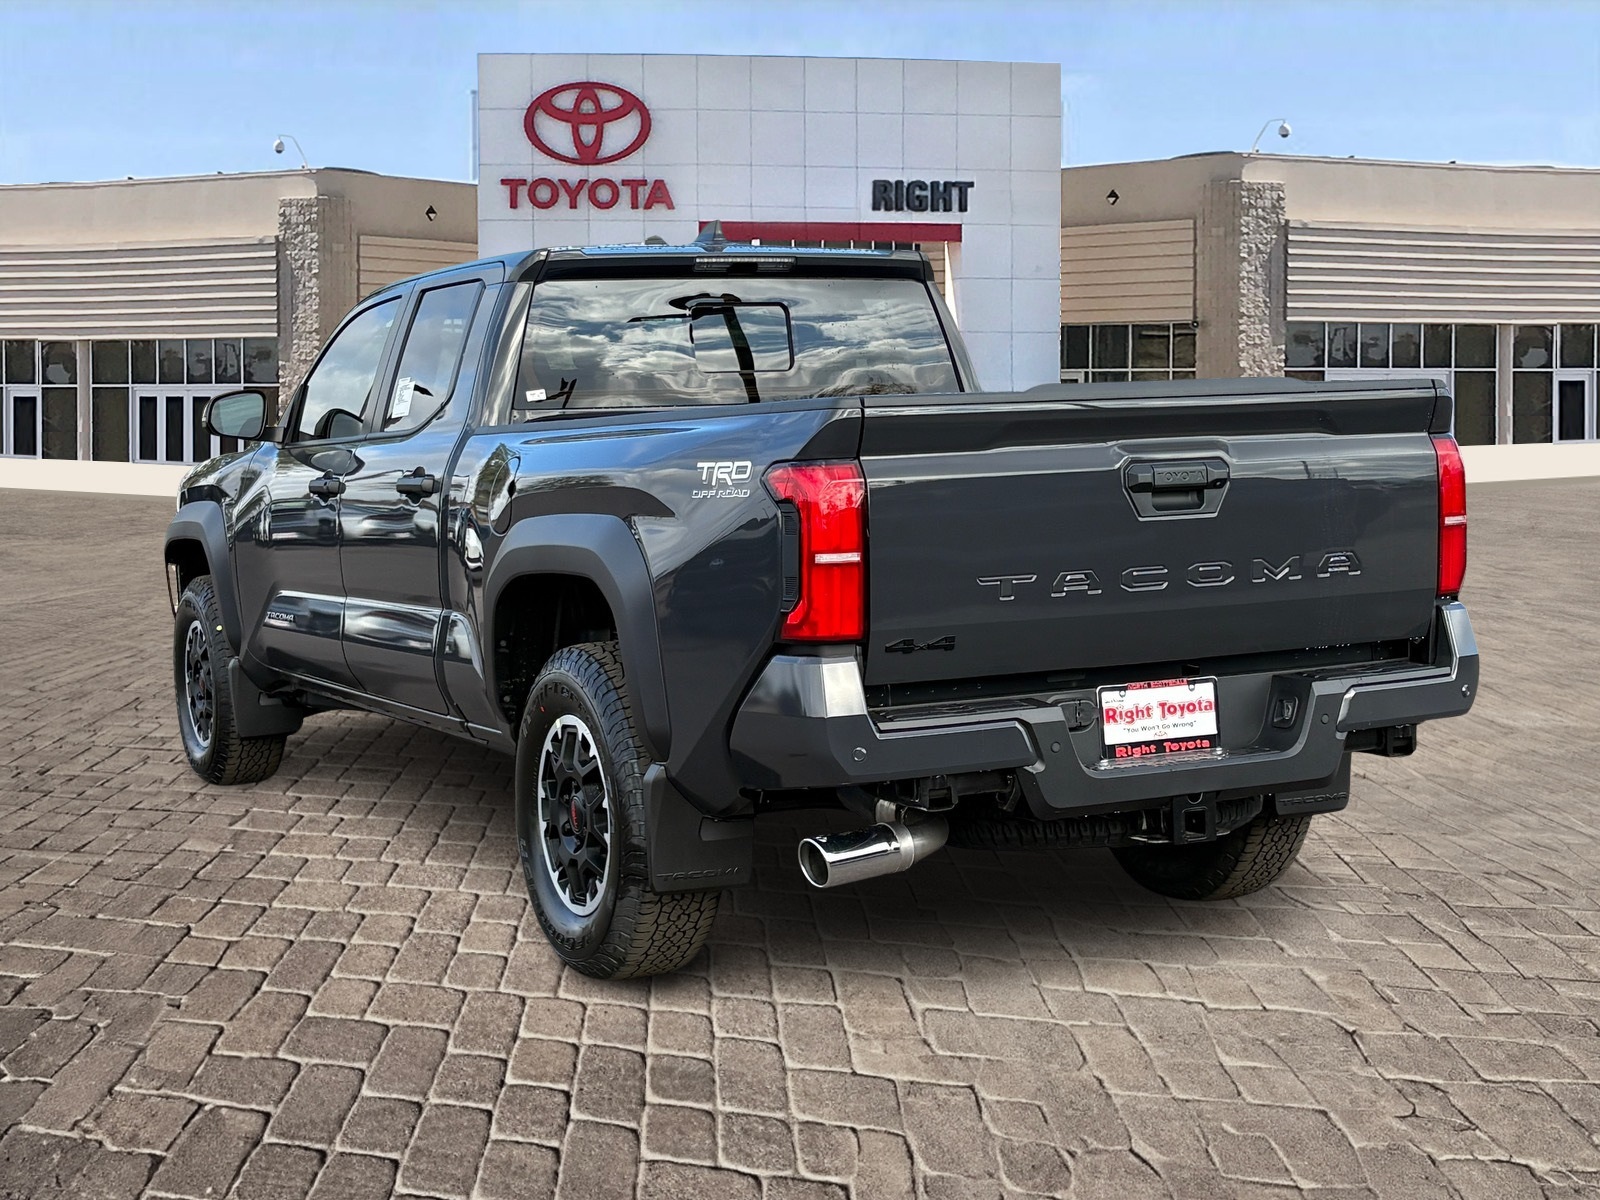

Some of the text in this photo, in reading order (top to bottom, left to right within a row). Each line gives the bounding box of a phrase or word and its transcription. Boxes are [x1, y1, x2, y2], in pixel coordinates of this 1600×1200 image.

[501, 178, 675, 210] TOYOTA
[872, 180, 975, 212] RIGHT
[696, 461, 752, 486] TRD
[1157, 469, 1206, 481] TOYOTA
[691, 490, 716, 498] OFF
[976, 551, 1361, 601] TACOMA
[265, 611, 294, 621] TACOMA
[1104, 699, 1213, 724] Right Toyota
[1141, 724, 1160, 732] Won't
[1115, 739, 1210, 758] Right Toyota
